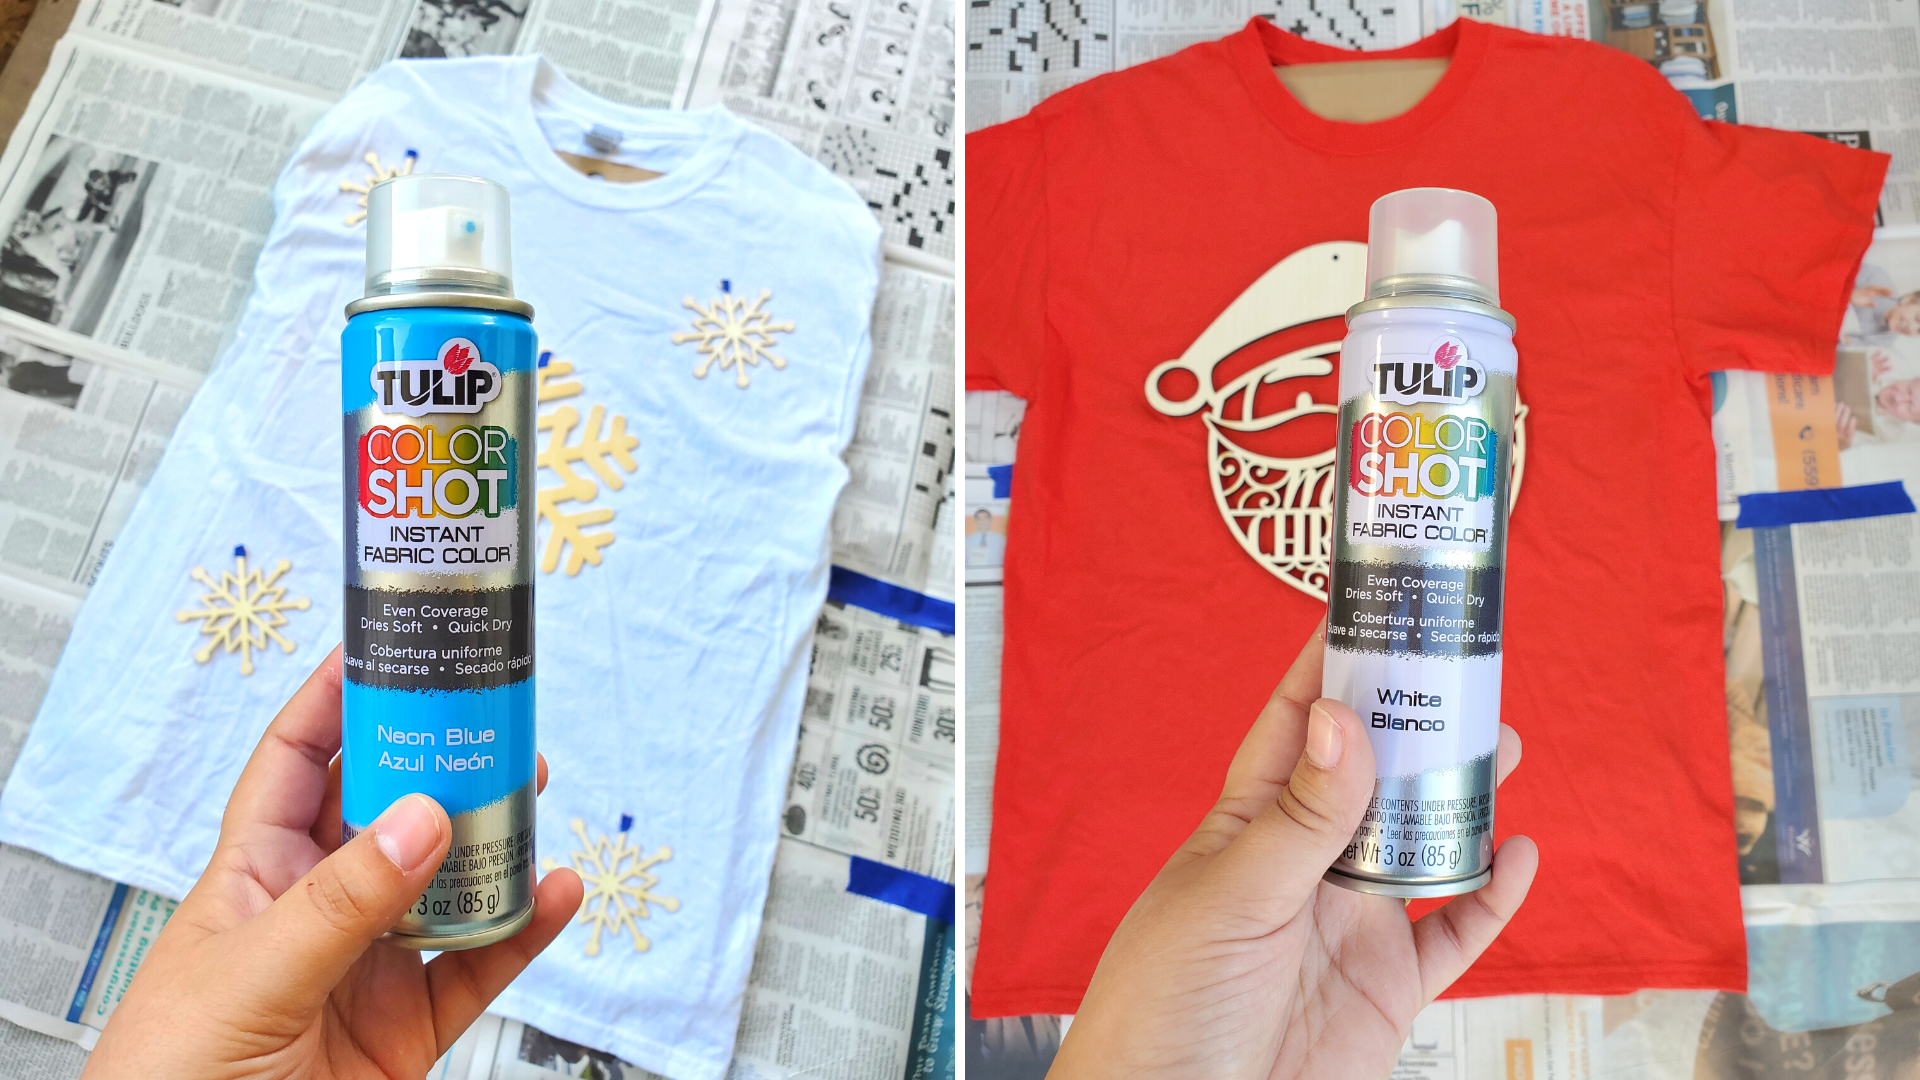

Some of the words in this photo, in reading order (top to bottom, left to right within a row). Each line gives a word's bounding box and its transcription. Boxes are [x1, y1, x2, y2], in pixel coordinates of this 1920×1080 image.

[1360, 415, 1487, 455] COLOR
[367, 428, 507, 465] COLOR
[1356, 451, 1487, 499] SHOT
[367, 468, 508, 516] SHOT
[1377, 503, 1464, 523] INSTANT
[390, 525, 484, 542] INSTANT
[1352, 522, 1417, 539] FABRIC
[1424, 525, 1487, 543] COLOR
[364, 546, 435, 564] FABRIC
[442, 545, 511, 564] COLOR
[1367, 575, 1397, 587] Even
[1401, 576, 1464, 592] Coverage
[1345, 587, 1372, 600] Dries
[1375, 589, 1403, 602] Soft
[1426, 592, 1463, 605] Quick
[1466, 594, 1485, 607] Dry
[383, 603, 416, 617] Even
[420, 605, 489, 619] Coverage
[1352, 611, 1415, 627] Cobertura
[1419, 616, 1475, 628] uniforme
[361, 616, 389, 631] Dries
[393, 620, 423, 633] Soft
[448, 619, 489, 634] Quick
[492, 618, 513, 632] Dry
[1348, 625, 1357, 637] al
[1359, 628, 1407, 641] secarse
[1430, 631, 1475, 643] Secado
[370, 643, 437, 659] Cobertura
[442, 645, 503, 659] uniforme
[366, 659, 375, 671] al
[378, 664, 429, 675] secarse
[455, 660, 504, 675] Secado
[507, 653, 532, 670] rápido
[1376, 687, 1442, 707] White
[1371, 711, 1445, 732] Blanco
[378, 725, 434, 746] Neon
[446, 728, 495, 746] Blue
[378, 751, 424, 772] Azul
[435, 752, 494, 772] Neón
[1381, 797, 1419, 812] CONTENTS
[1421, 799, 1446, 812] UNDER
[1388, 812, 1432, 826] INFLAMABLE
[1434, 812, 1451, 825] BAJO
[1359, 823, 1377, 839] panel
[1386, 825, 1401, 840] Leer
[1403, 827, 1413, 841] las
[1414, 828, 1456, 843] precauciones
[1457, 829, 1465, 839] en
[1465, 825, 1471, 838] el
[454, 844, 480, 858] UNDER
[1361, 841, 1381, 864] Wt
[1384, 844, 1394, 866] 3
[1398, 851, 1416, 867] oz
[1421, 843, 1446, 868] (85
[1449, 841, 1462, 870] g)
[469, 857, 487, 871] BAJO
[437, 874, 447, 889] las
[450, 872, 493, 891] precauciones
[494, 870, 502, 882] en
[503, 863, 509, 878] el
[418, 894, 428, 916] 3
[433, 901, 451, 916] oz
[457, 890, 483, 915] (85
[487, 884, 500, 915] g)
[143, 916, 155, 932] to
[97, 910, 140, 1016] Congressman
[928, 1014, 944, 1053] Grow
